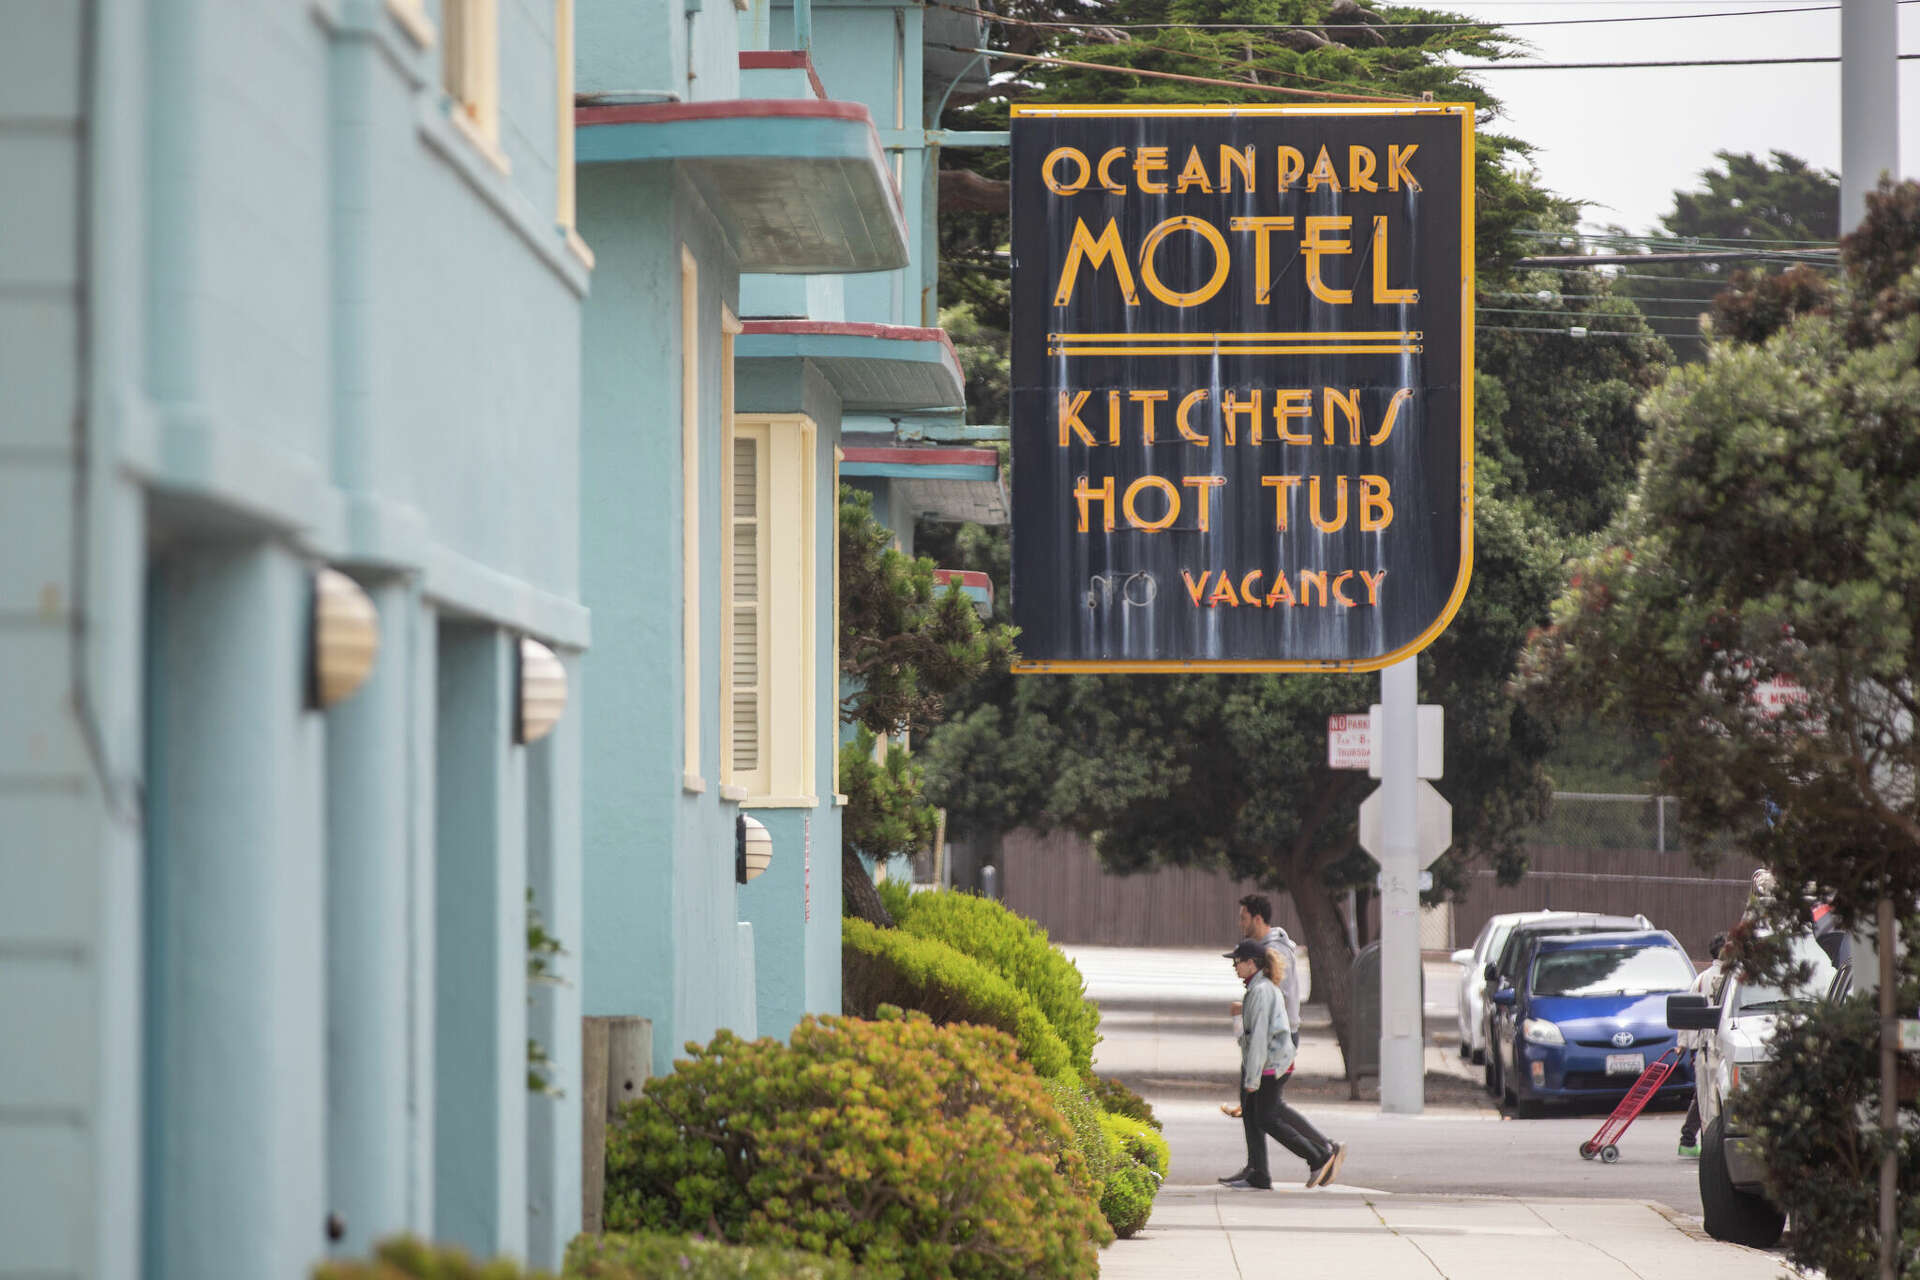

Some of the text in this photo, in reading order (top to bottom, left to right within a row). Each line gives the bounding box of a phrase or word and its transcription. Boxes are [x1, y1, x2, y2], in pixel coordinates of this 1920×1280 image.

[1042, 144, 1423, 196] OCEAN PARK
[1053, 216, 1419, 307] MOTEL
[1059, 387, 1414, 446] KITCHENS
[1074, 475, 1394, 533] HOT TUB
[1086, 569, 1387, 608] NO VACANCY
[1331, 716, 1346, 731] NO
